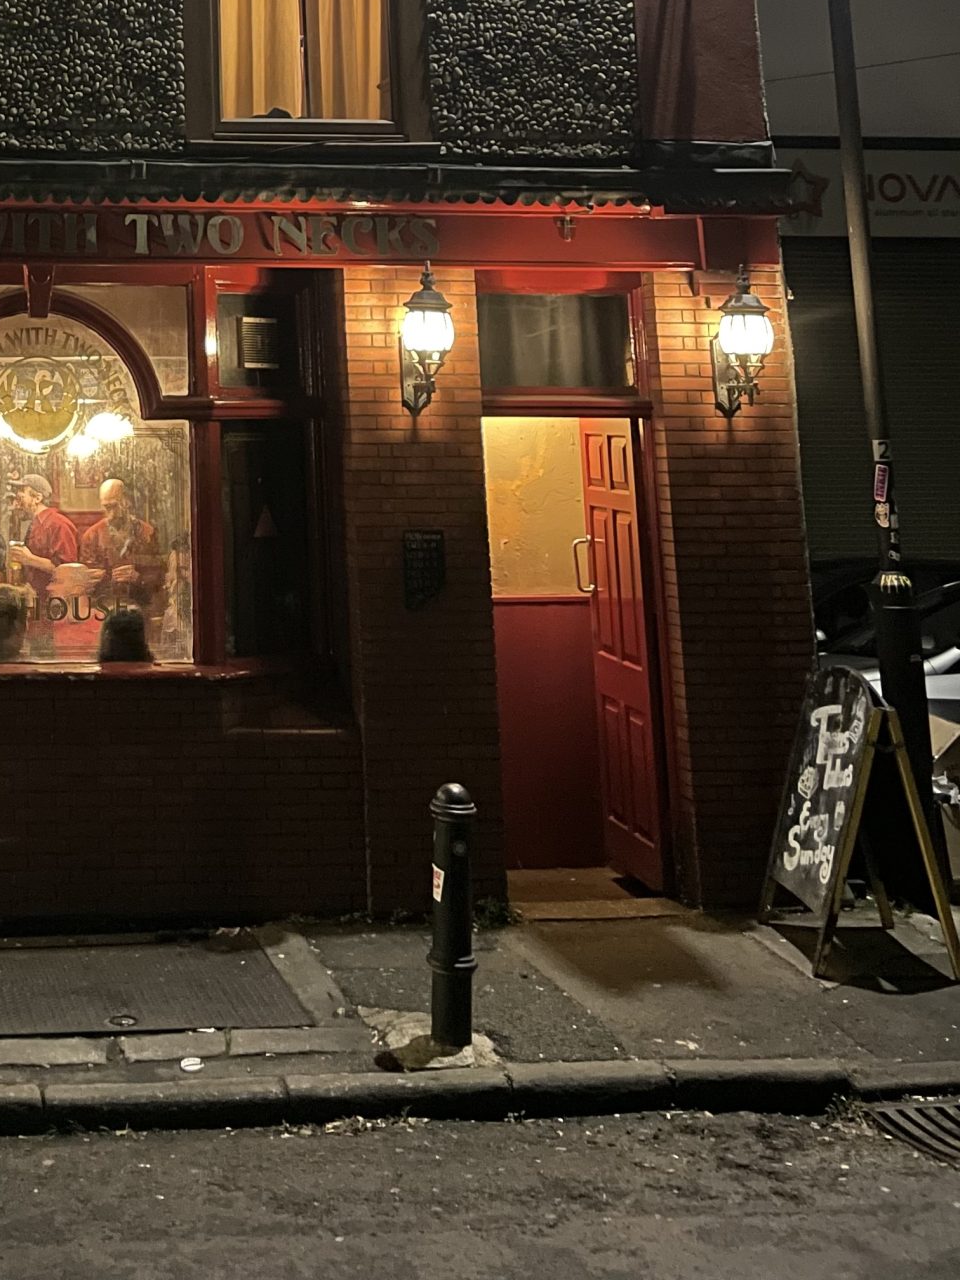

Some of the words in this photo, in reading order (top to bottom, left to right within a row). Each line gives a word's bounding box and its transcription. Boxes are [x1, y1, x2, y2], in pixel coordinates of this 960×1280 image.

[124, 211, 244, 256] TWO
[270, 211, 439, 257] NECKS
[5, 327, 57, 349] WITH
[62, 331, 101, 366] TWO
[783, 824, 835, 884] Sunday
